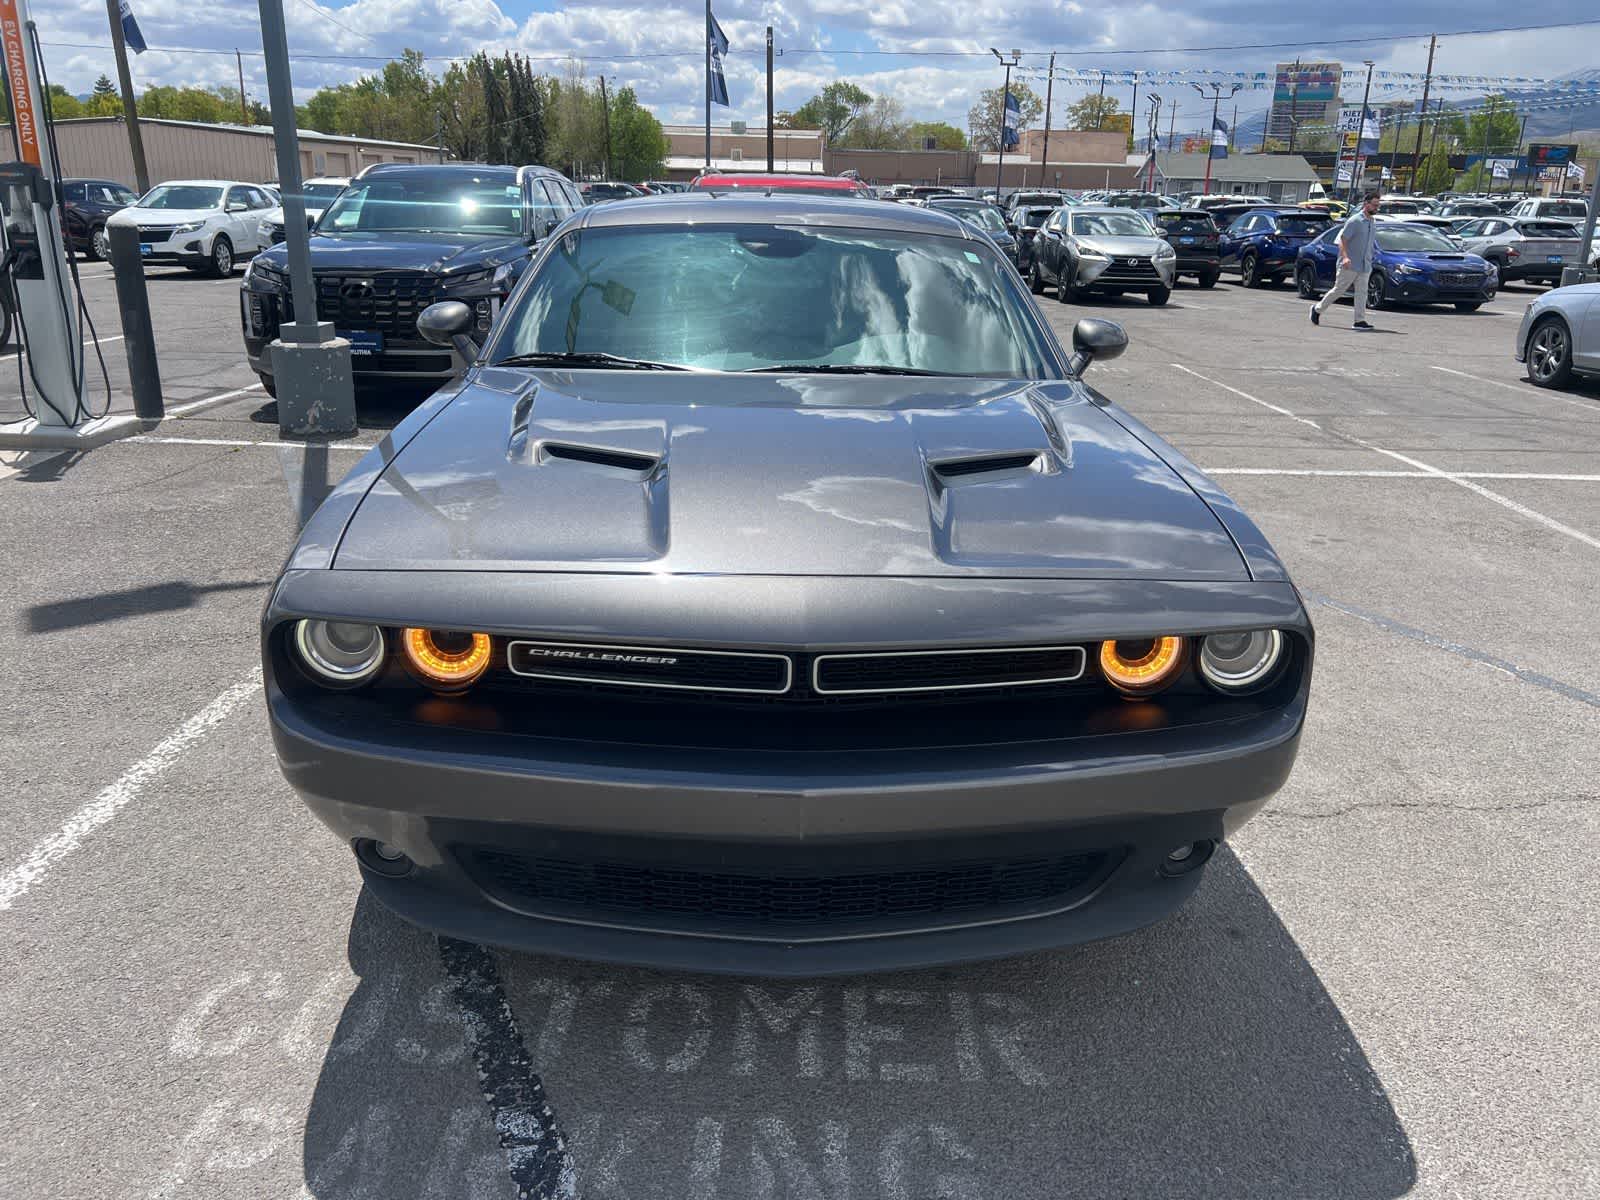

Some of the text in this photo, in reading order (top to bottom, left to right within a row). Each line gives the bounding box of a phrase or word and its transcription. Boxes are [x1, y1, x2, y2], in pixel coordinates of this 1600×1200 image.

[5, 20, 34, 145] EV CHARGING ONLY
[529, 648, 677, 664] CHALLENGER
[168, 970, 1048, 1088] CUSTOMER
